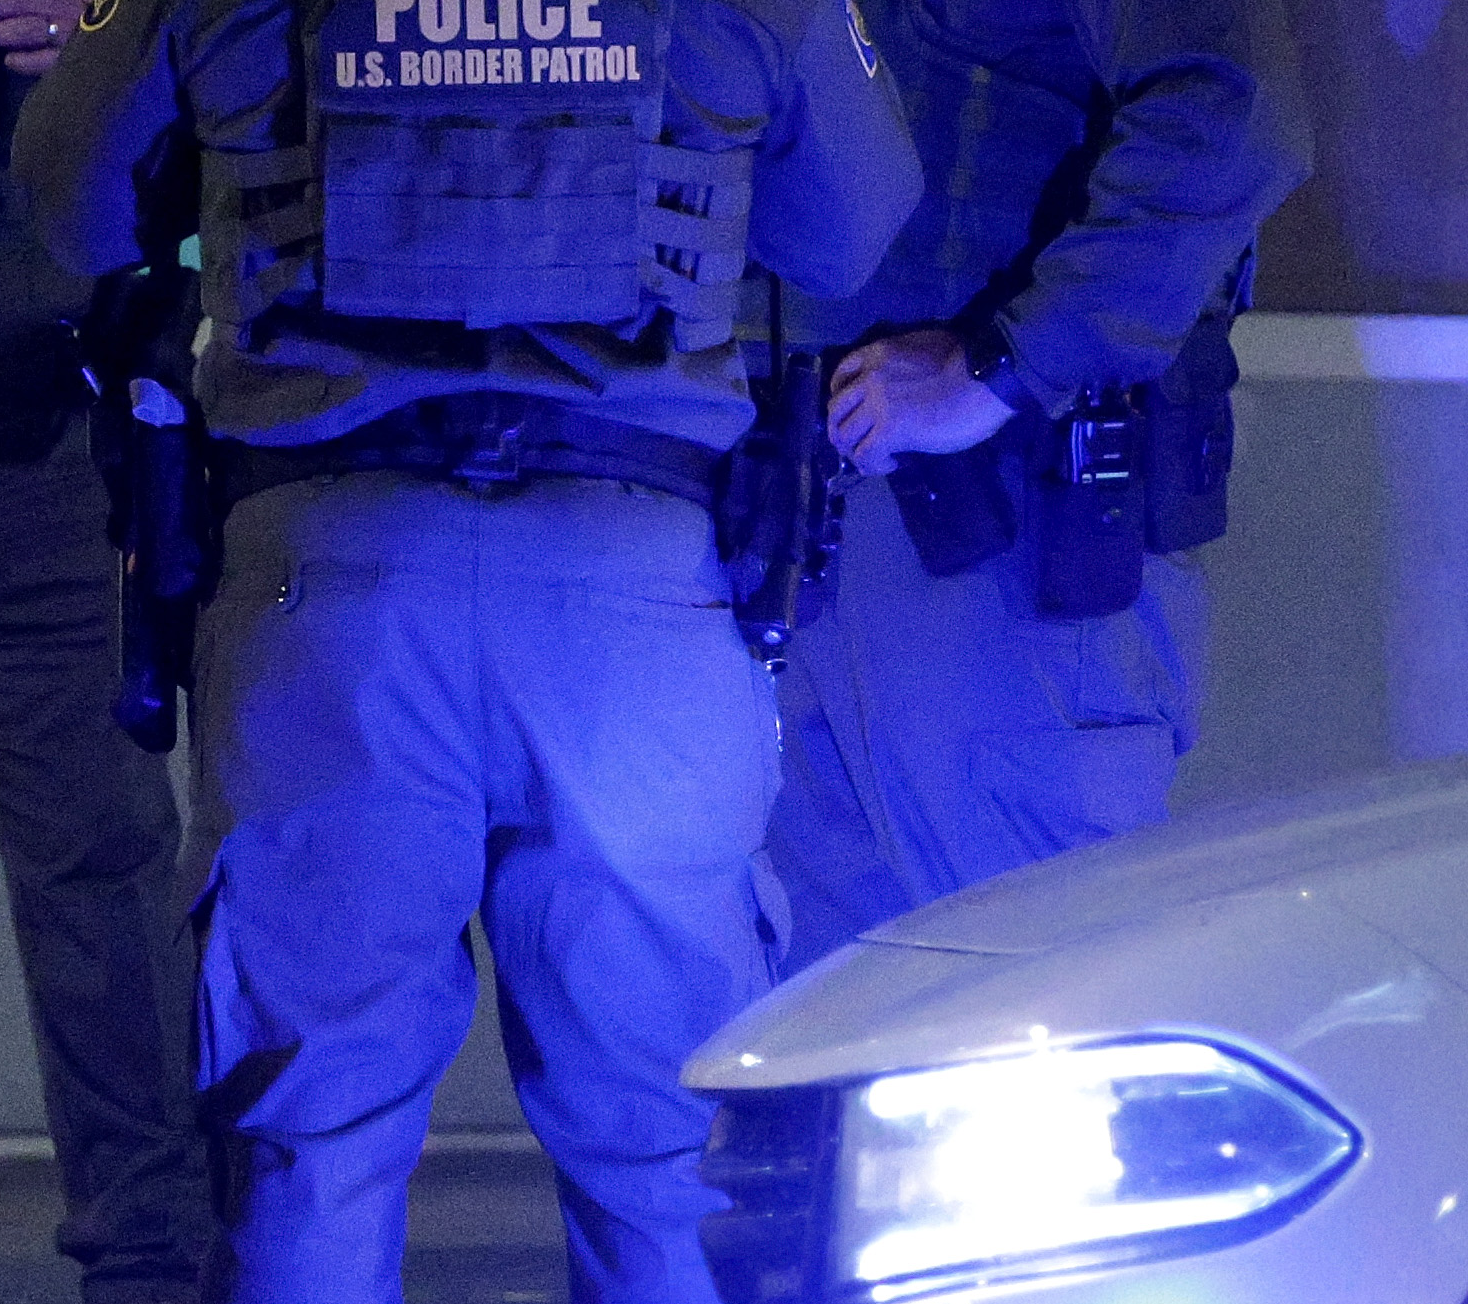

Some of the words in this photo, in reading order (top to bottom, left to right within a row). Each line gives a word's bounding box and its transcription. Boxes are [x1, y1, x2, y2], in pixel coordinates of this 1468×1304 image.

[335, 51, 393, 88] U.S.
[399, 48, 524, 86] BORDER
[530, 45, 641, 83] PATROL
